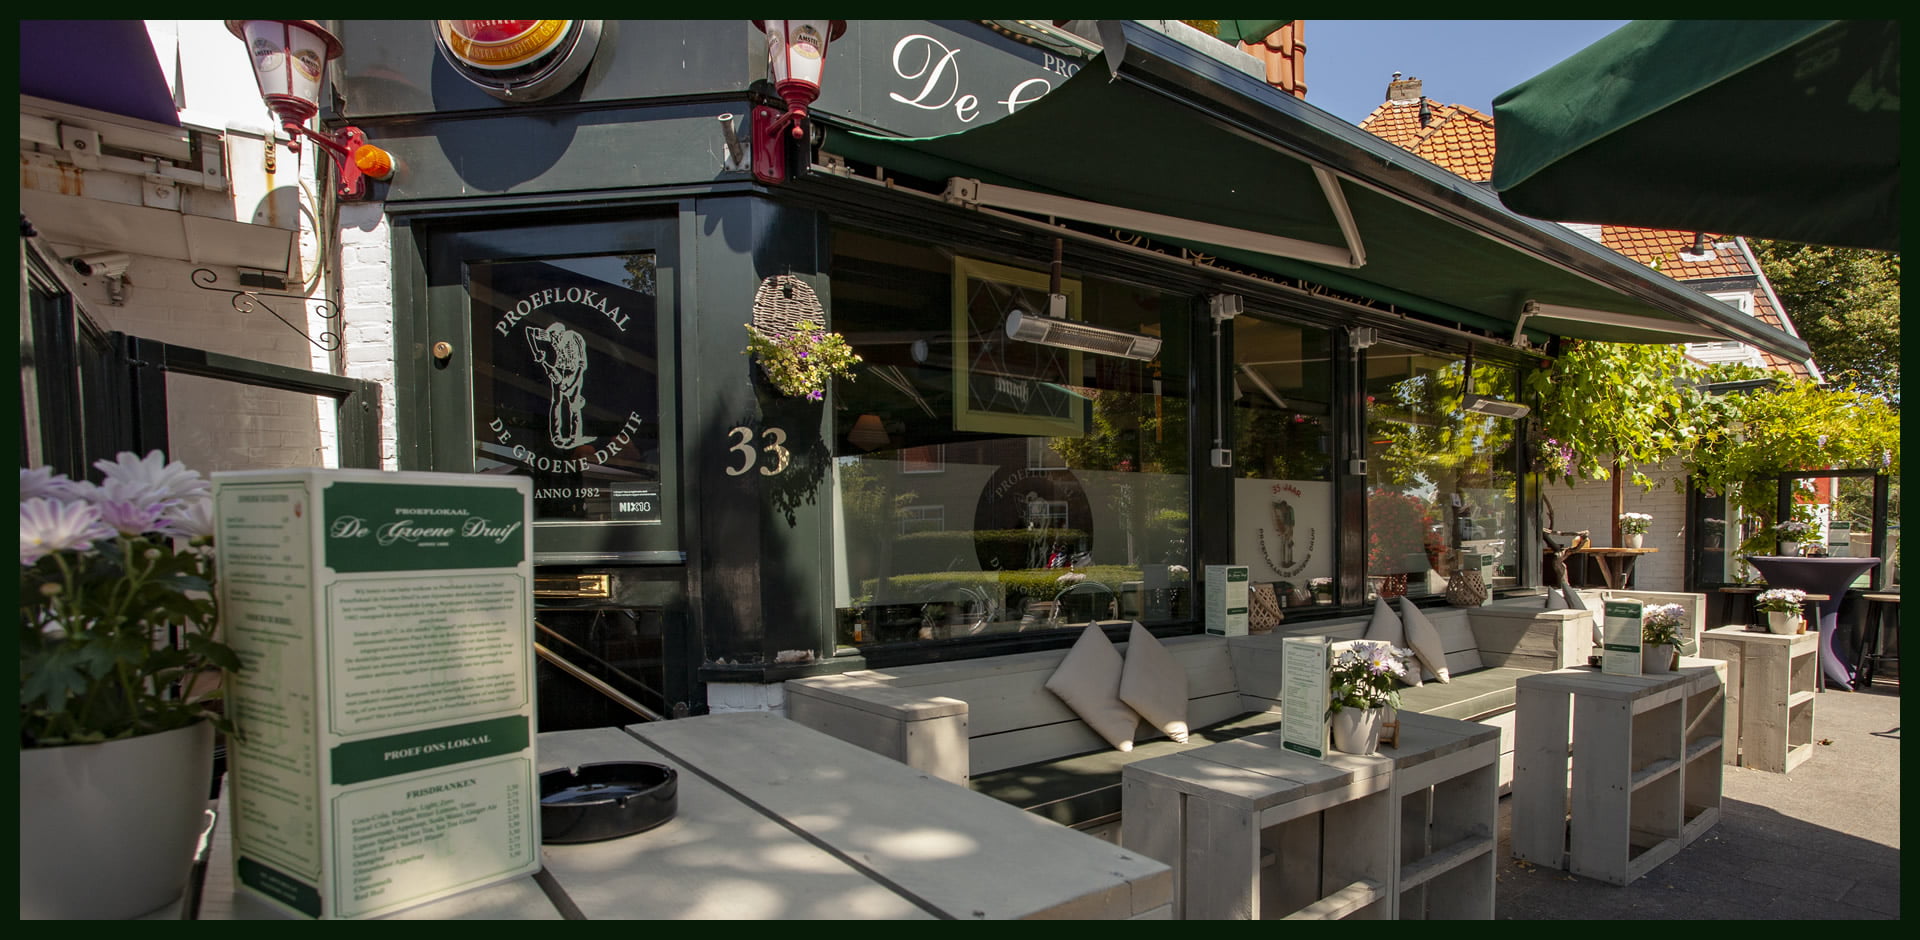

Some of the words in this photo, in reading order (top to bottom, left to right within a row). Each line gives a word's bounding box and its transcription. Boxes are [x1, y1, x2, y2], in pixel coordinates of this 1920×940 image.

[798, 34, 818, 45] AMSTEL
[889, 34, 979, 122] De
[495, 286, 633, 337] PROEFLOKAAL
[489, 417, 511, 445] DE
[513, 444, 590, 474] GROENE
[595, 410, 643, 465] DRUIF
[726, 426, 790, 476] 33
[534, 488, 572, 499] ANNO
[575, 487, 600, 498] 1982
[619, 501, 651, 512] NIX18
[395, 508, 470, 516] PROEFLOKAAL
[330, 515, 370, 538] De
[376, 519, 456, 546] Groene
[462, 516, 521, 544] Druif
[384, 747, 422, 761] PROEF
[422, 742, 446, 754] ONS
[447, 734, 491, 750] LOKAAL
[406, 779, 476, 799] FRISDRANKEN
